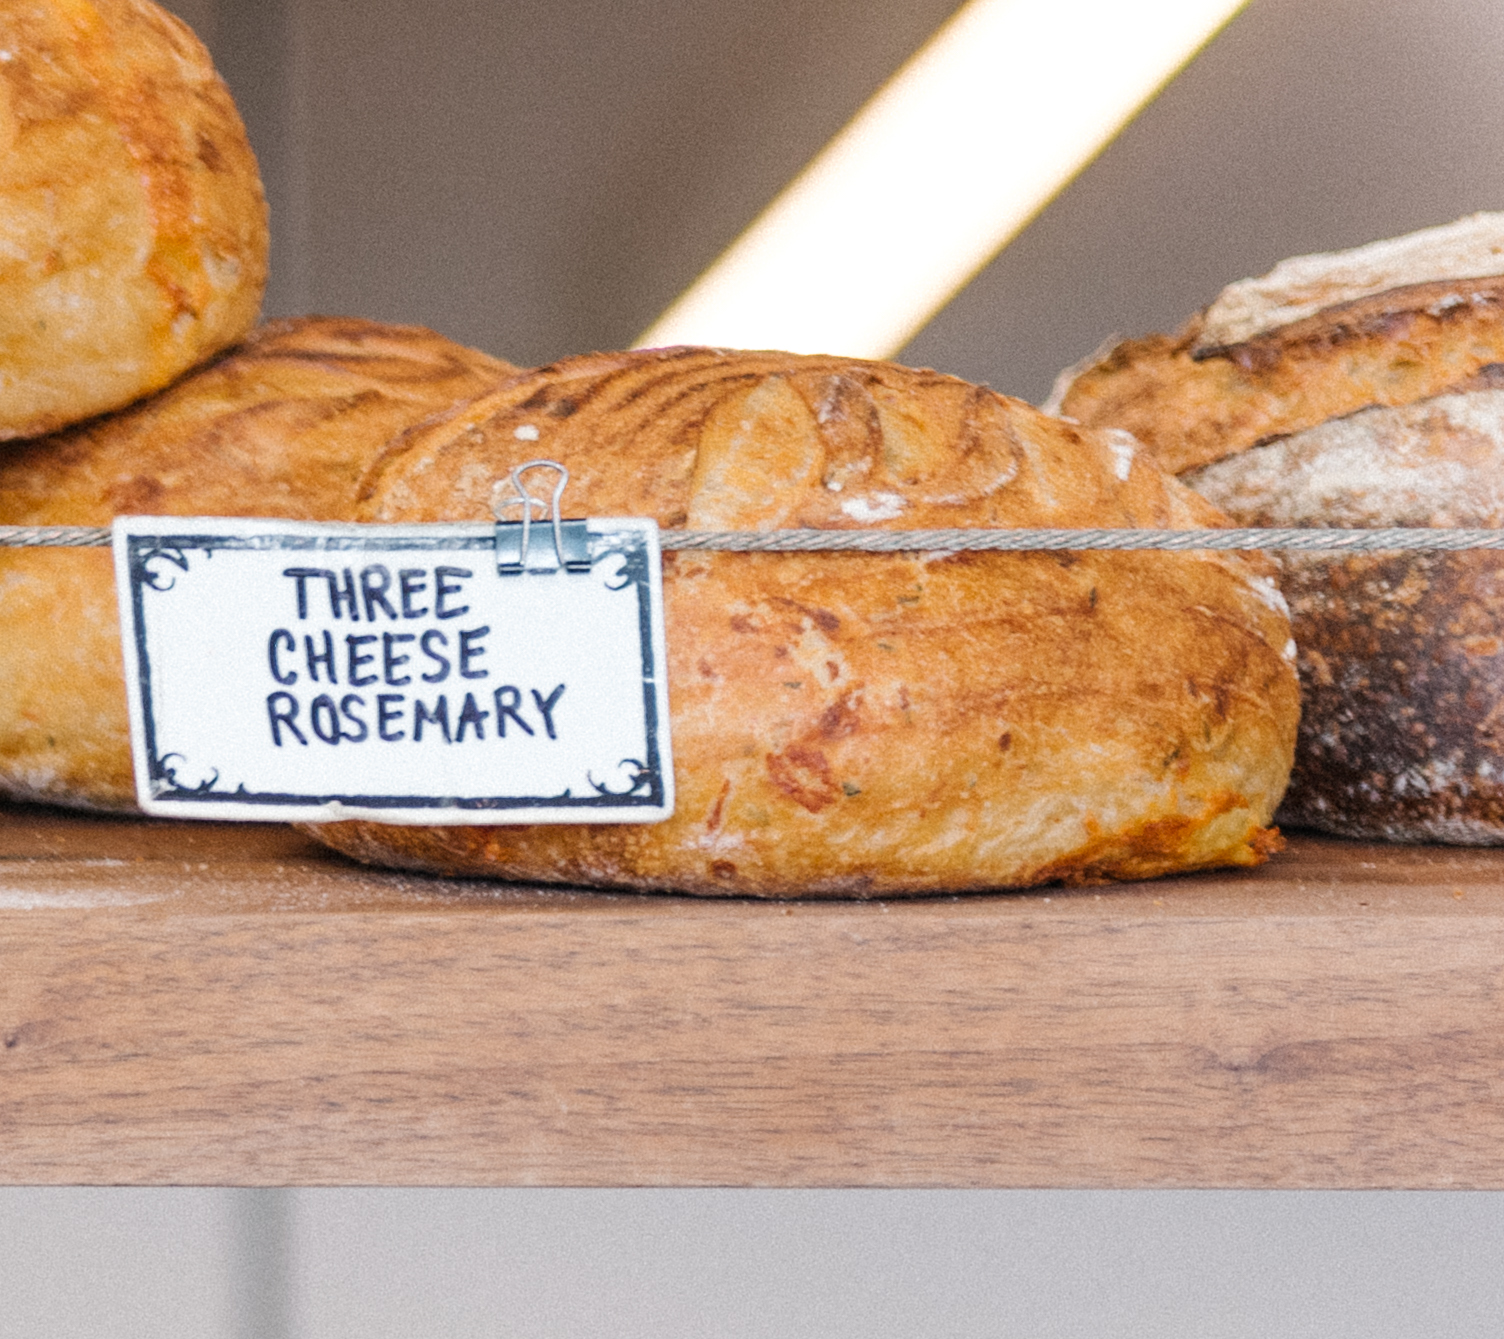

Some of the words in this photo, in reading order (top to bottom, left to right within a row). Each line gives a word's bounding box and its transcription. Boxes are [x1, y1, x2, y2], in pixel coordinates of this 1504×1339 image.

[281, 564, 475, 624] THREE
[266, 624, 492, 688] CHEESE
[265, 682, 567, 747] ROSEMARY
